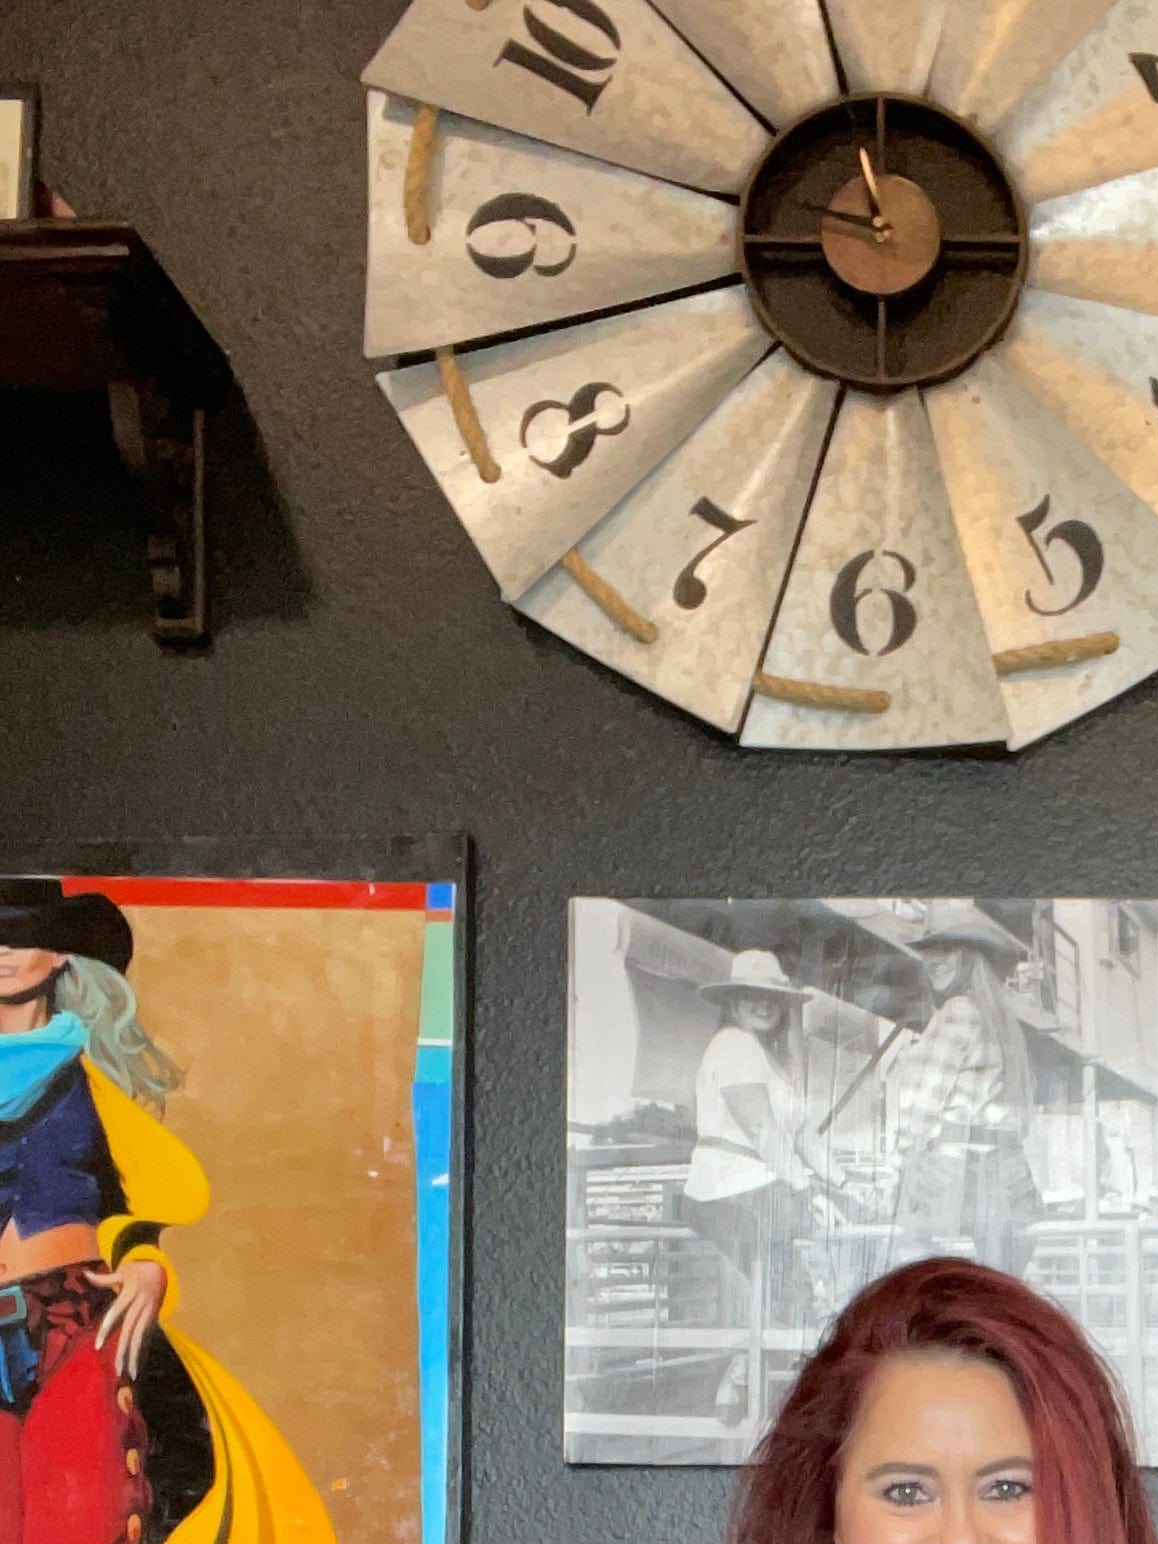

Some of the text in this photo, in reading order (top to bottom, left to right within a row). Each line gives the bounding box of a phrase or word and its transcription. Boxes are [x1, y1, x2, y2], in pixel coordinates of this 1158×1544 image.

[493, 0, 622, 116] 10
[467, 193, 577, 278] 9
[520, 382, 629, 478] 8
[674, 497, 756, 609] 7
[829, 550, 916, 656] 6
[1017, 494, 1105, 616] 5
